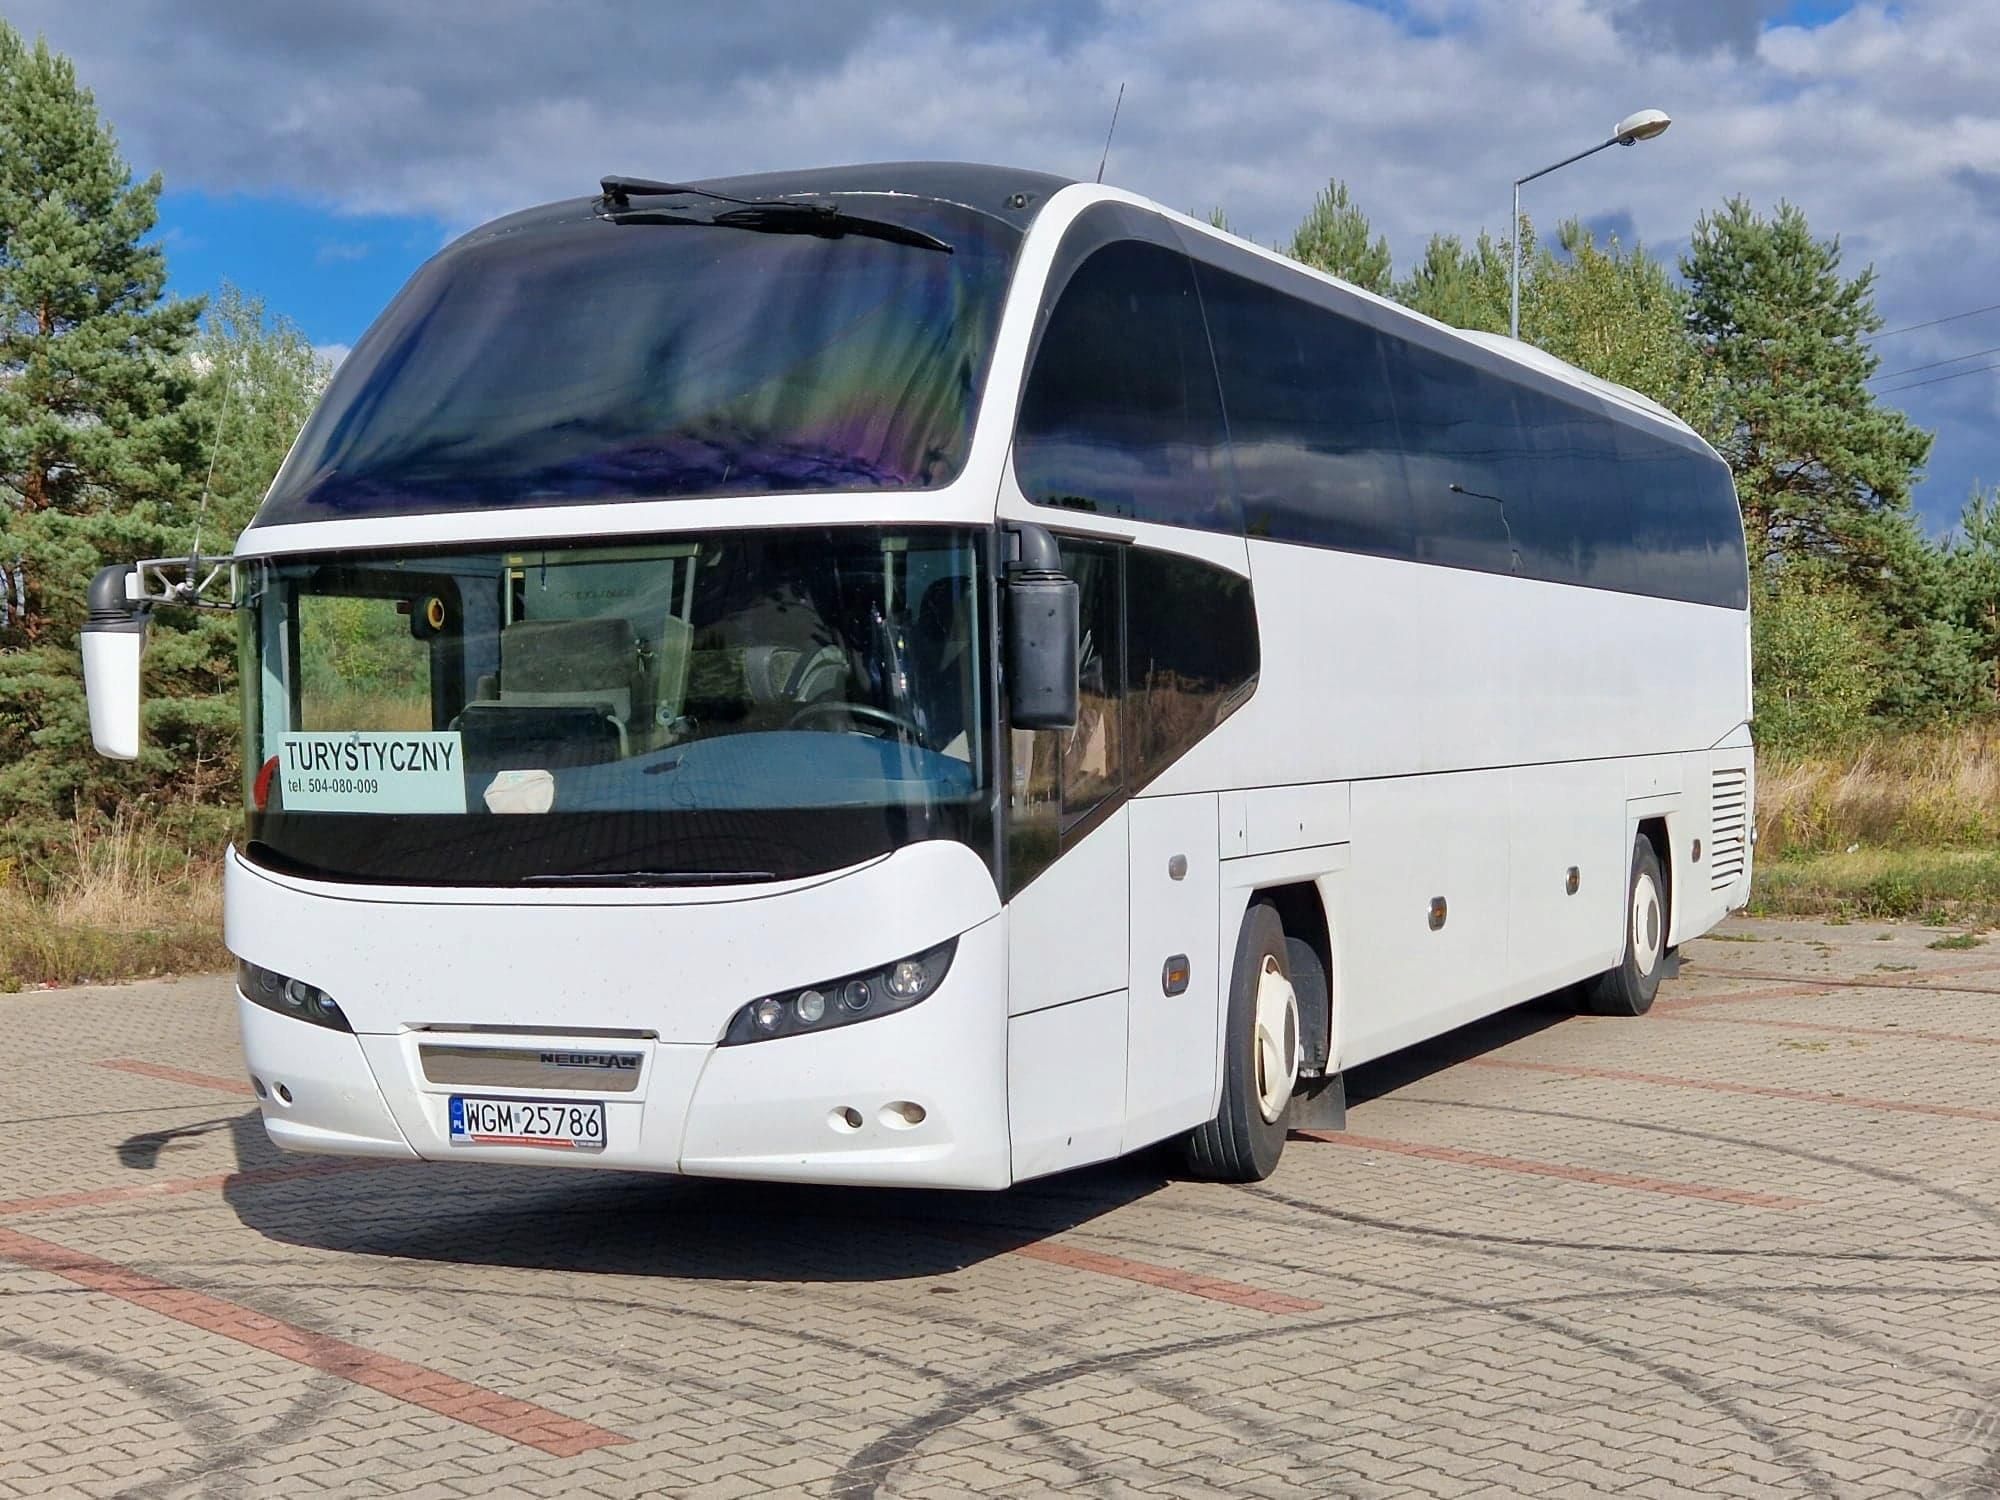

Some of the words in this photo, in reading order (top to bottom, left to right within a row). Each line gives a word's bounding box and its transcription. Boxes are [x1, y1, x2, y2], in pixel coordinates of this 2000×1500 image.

[285, 741, 454, 771] TURYSTYCZNY
[288, 778, 305, 793] tel.
[308, 778, 378, 794] 504-080-009
[540, 1053, 636, 1069] NEOPLAN
[453, 1119, 464, 1129] PL
[465, 1103, 514, 1134] WGM
[521, 1106, 600, 1138] 25786
